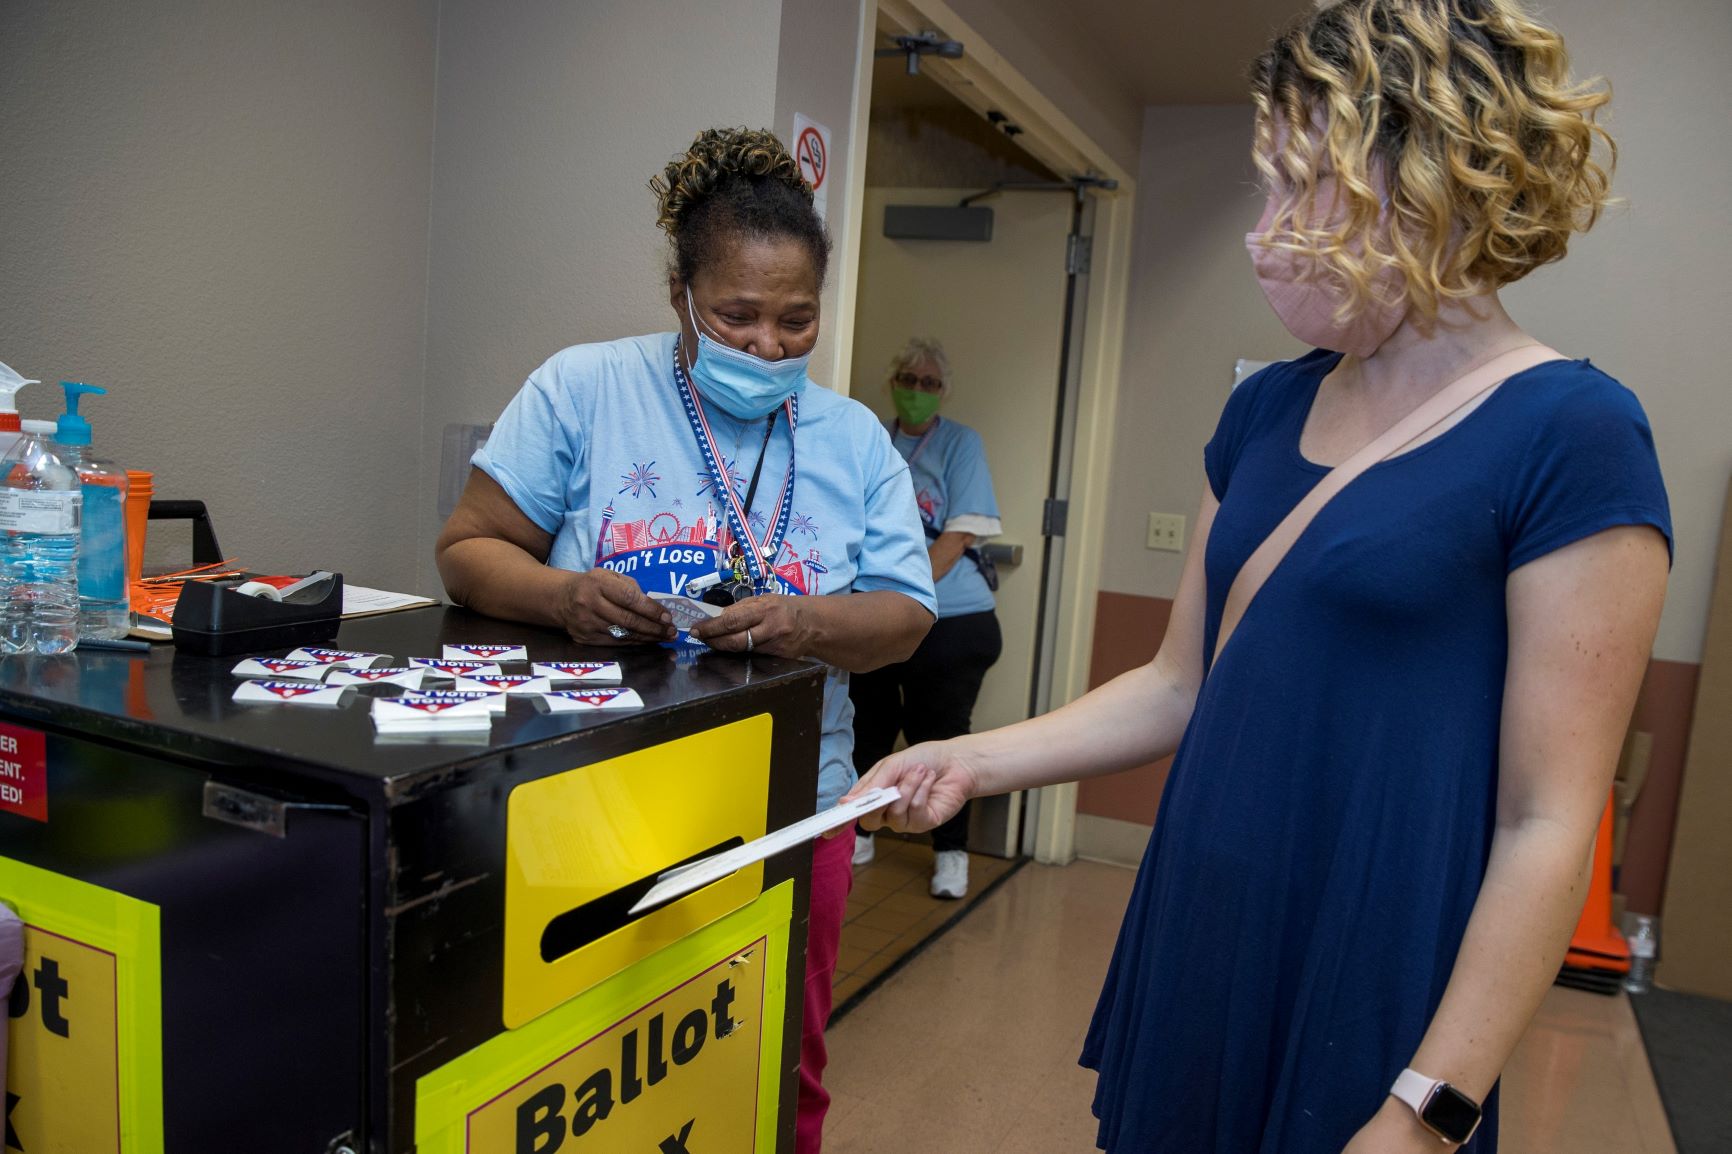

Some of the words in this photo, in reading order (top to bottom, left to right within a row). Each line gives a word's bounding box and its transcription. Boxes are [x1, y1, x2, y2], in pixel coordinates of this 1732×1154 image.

[659, 547, 706, 565] Lose
[320, 650, 364, 658] VOTED
[274, 681, 328, 690] VOTED
[573, 689, 619, 698] VOTED
[0, 784, 23, 805] ED!
[516, 978, 736, 1154] Ballot
